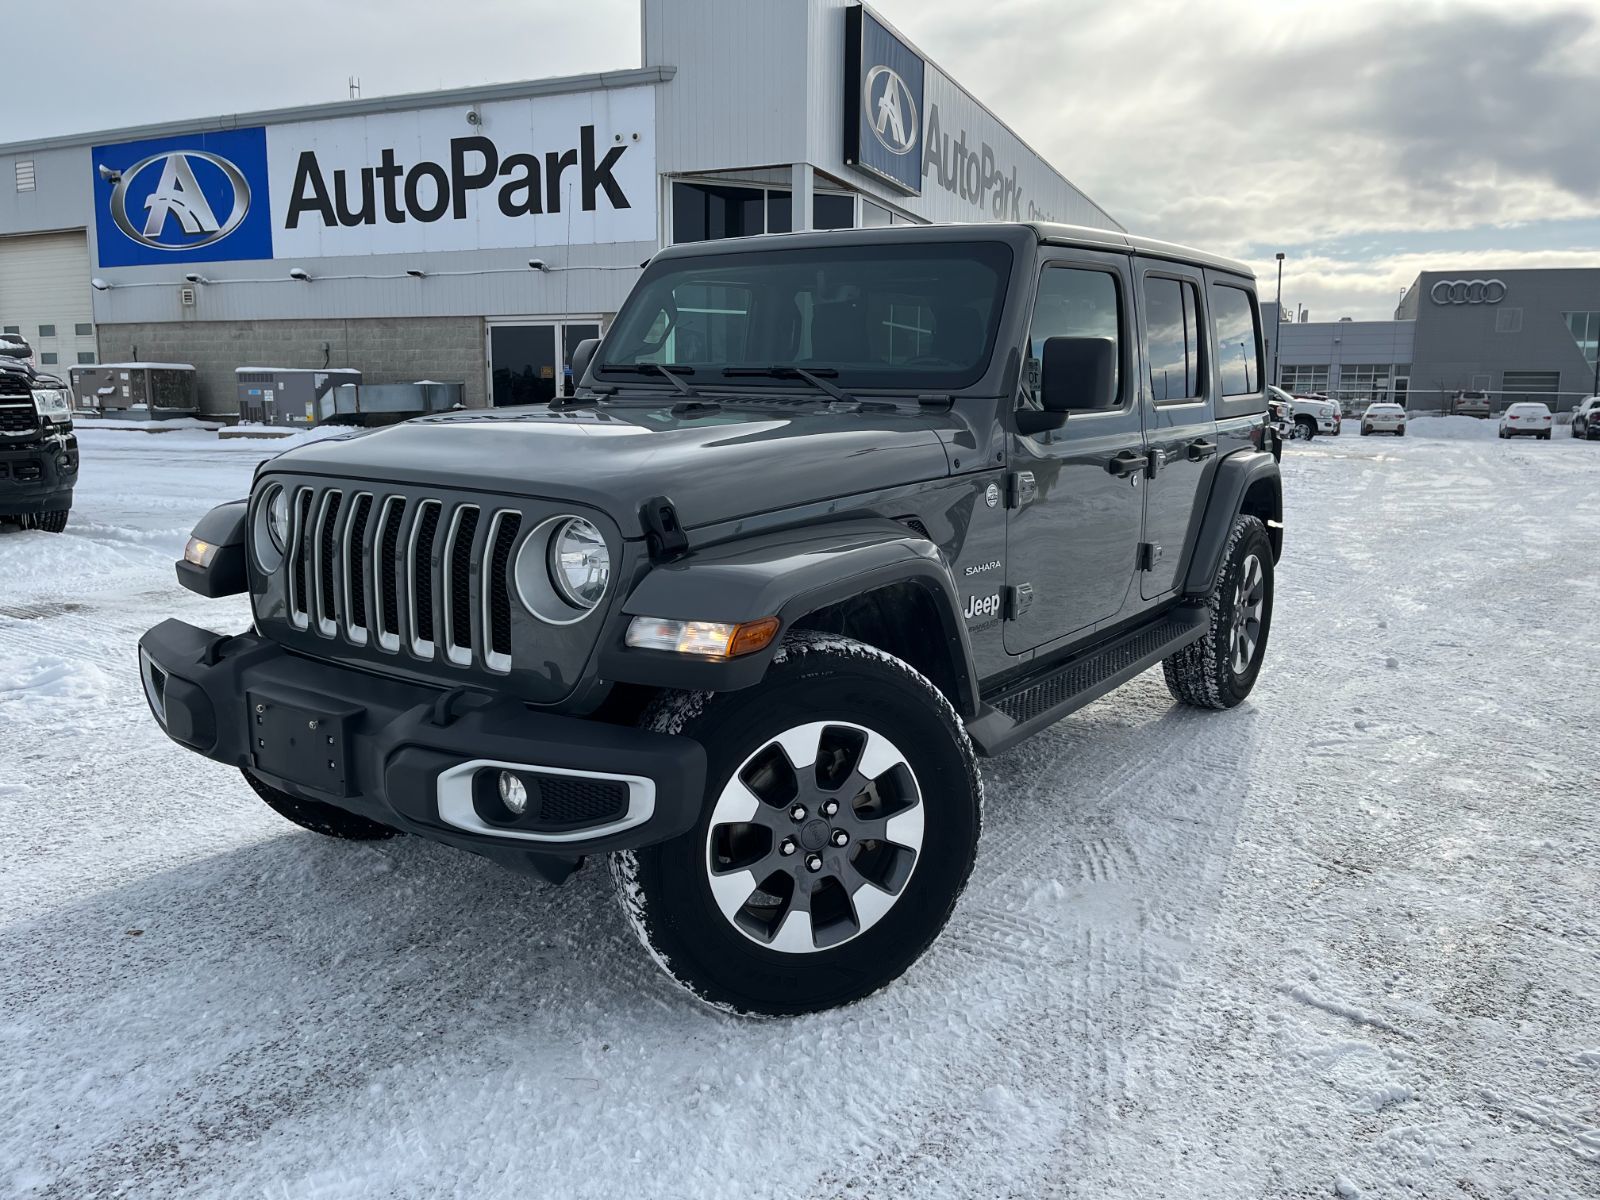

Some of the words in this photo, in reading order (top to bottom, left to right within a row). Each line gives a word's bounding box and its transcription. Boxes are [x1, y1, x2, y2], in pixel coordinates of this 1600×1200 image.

[285, 125, 631, 229] AutoPark
[921, 103, 1023, 222] AutoPark
[965, 560, 1001, 576] SAHARA
[964, 594, 1000, 619] Jeep
